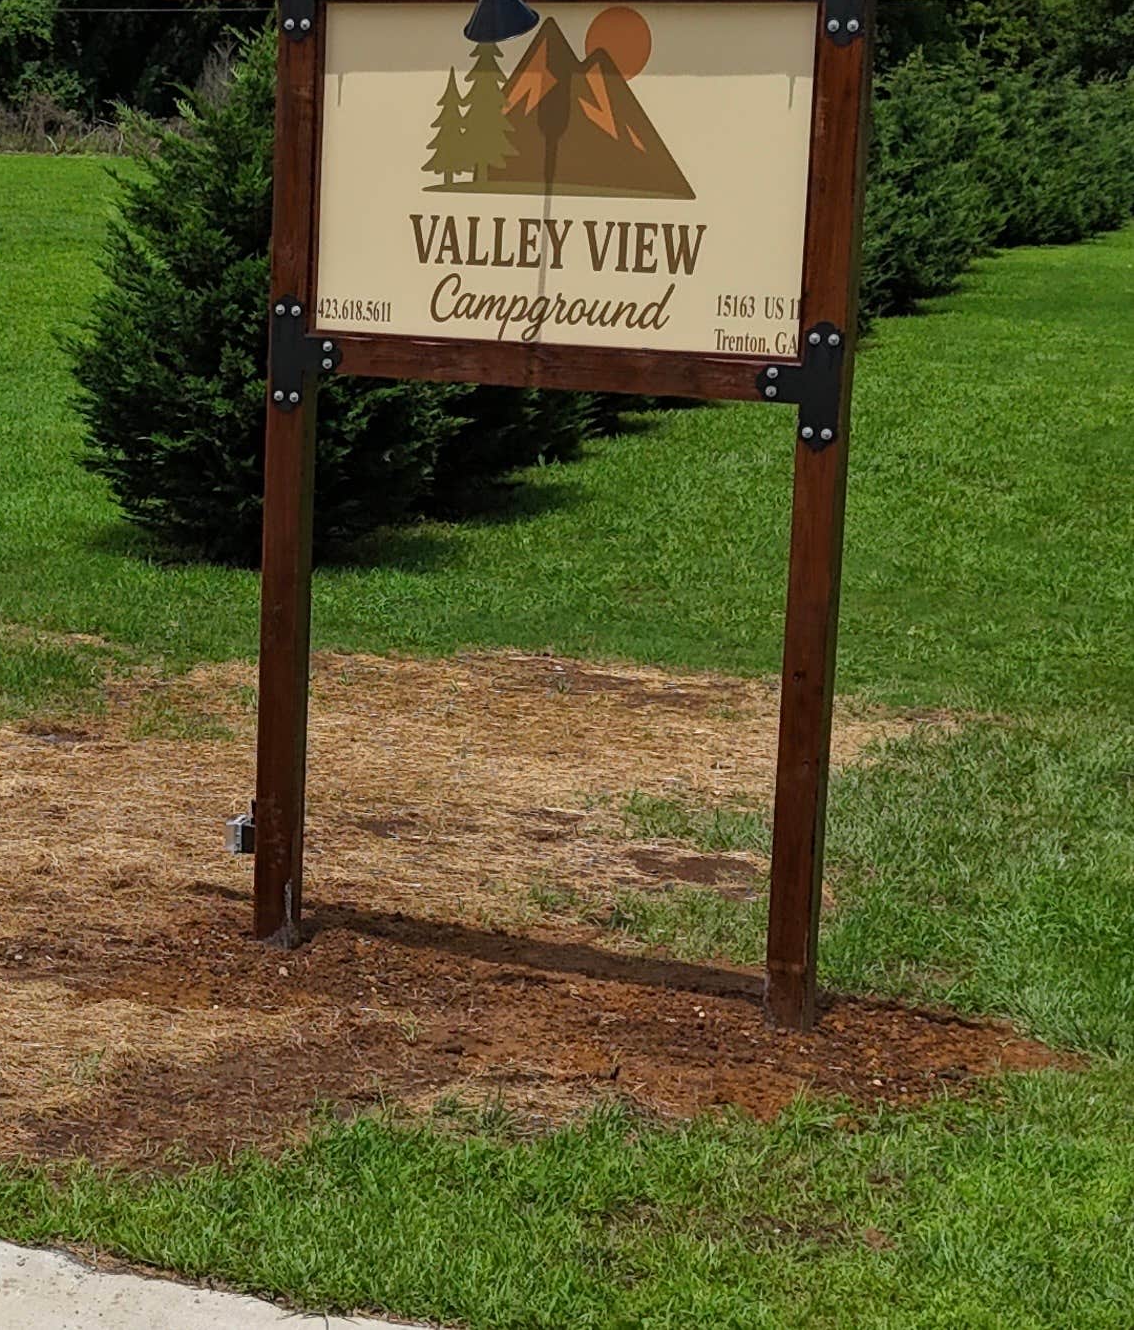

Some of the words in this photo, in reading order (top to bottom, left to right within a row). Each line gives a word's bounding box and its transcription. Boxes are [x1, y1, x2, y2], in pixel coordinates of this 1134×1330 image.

[409, 214, 574, 270] VALLEY
[582, 220, 707, 275] VIEW
[317, 297, 391, 323] 423.618.5611
[429, 272, 676, 341] Campground
[716, 294, 755, 319] 15163
[764, 296, 784, 320] US
[714, 328, 770, 354] Trenton,
[775, 331, 797, 355] GA
